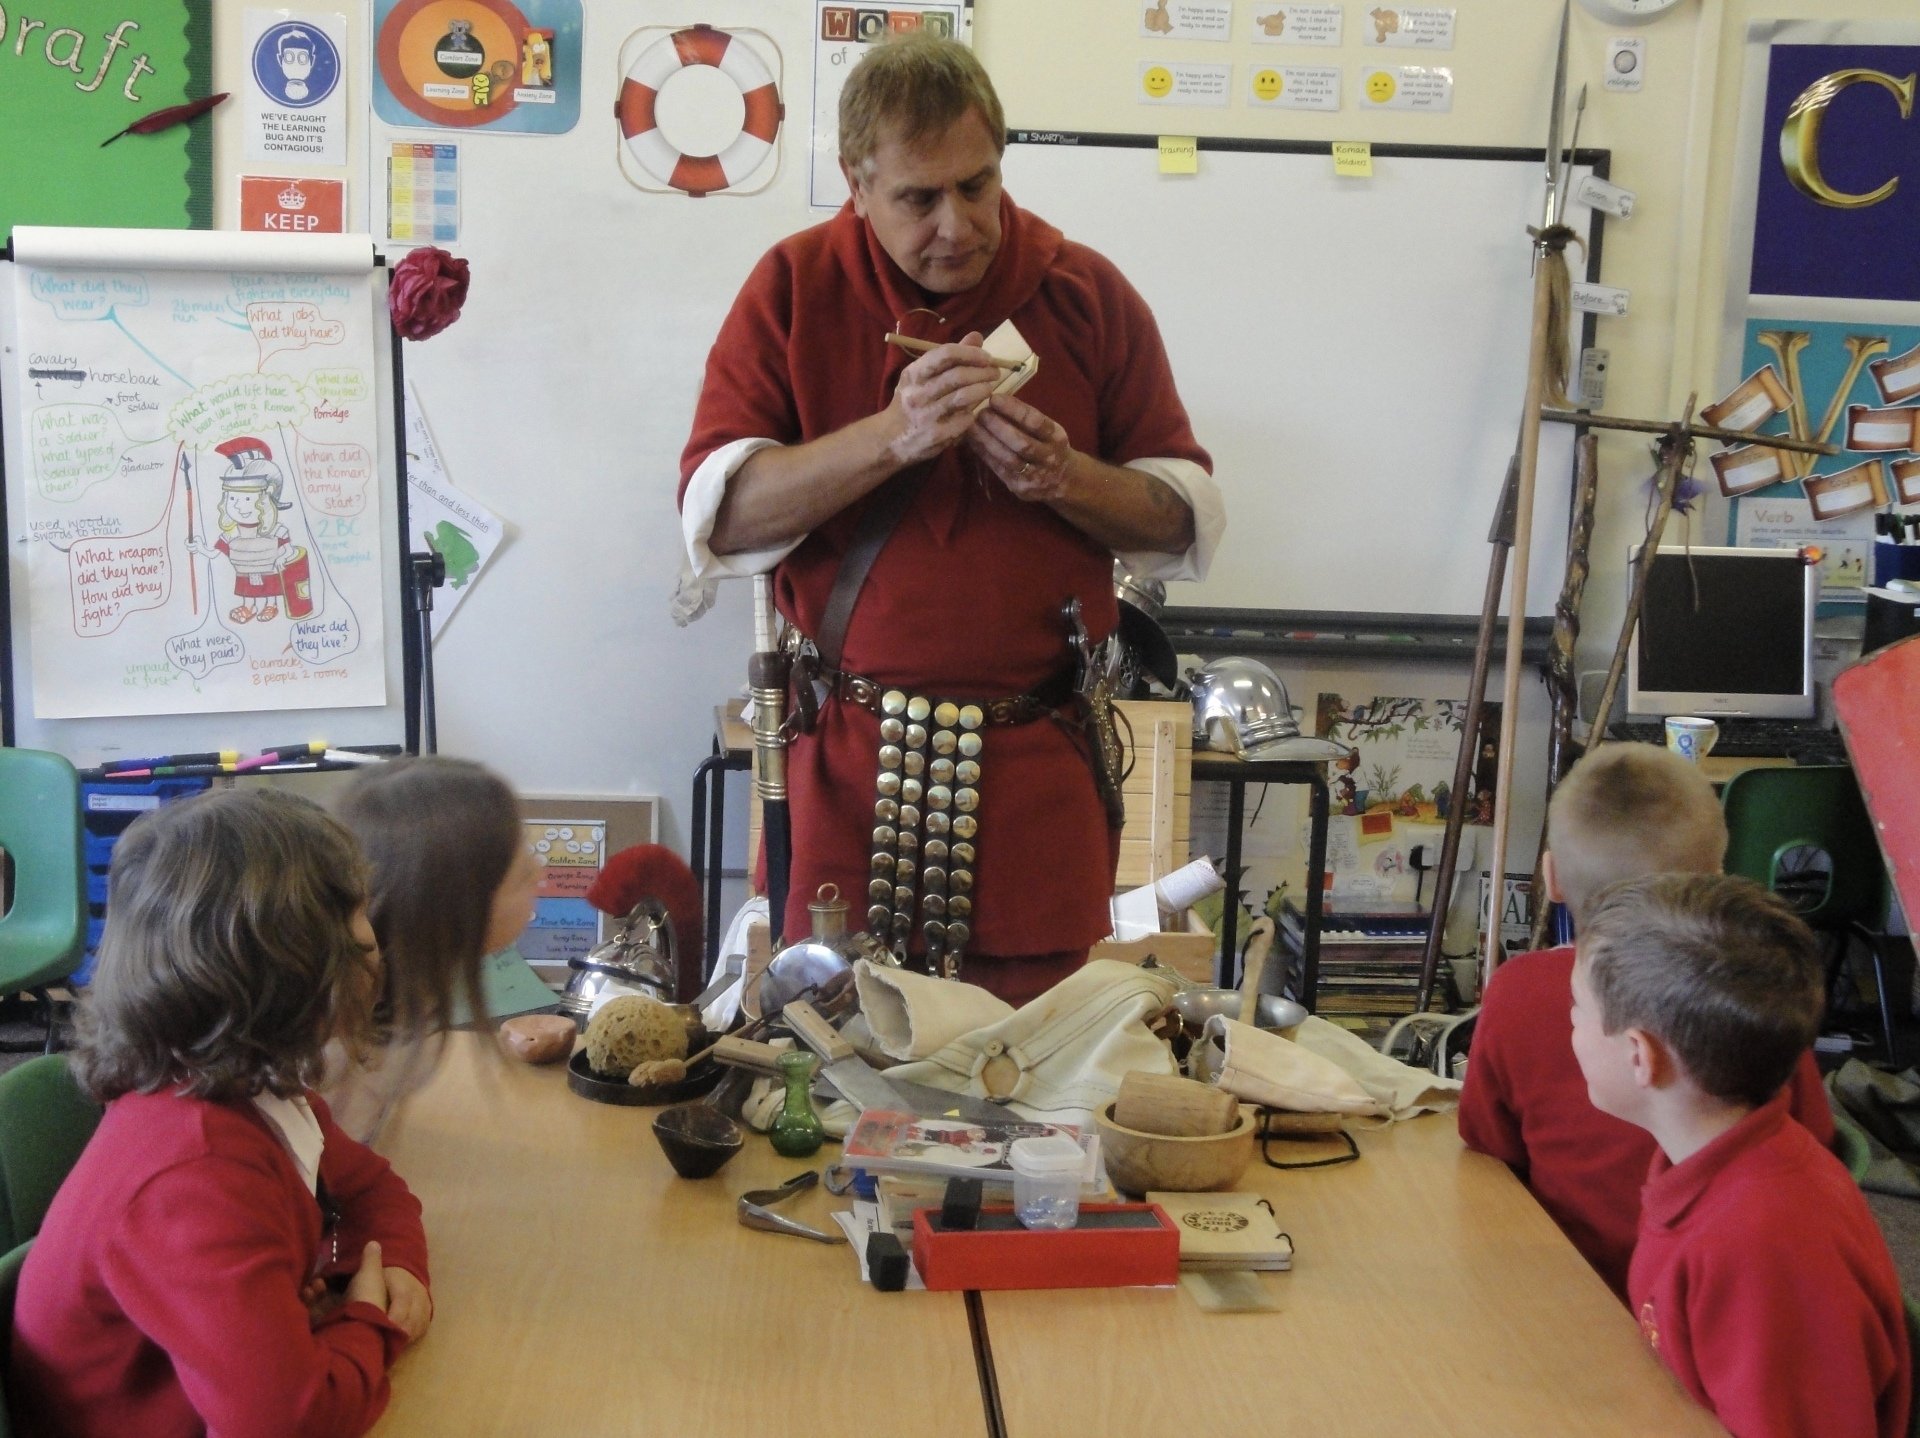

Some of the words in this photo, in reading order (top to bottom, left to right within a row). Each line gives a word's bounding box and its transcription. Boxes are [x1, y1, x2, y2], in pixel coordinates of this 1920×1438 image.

[830, 47, 847, 65] of
[261, 113, 288, 122] WE'VE
[290, 114, 327, 123] CAUGHT
[262, 123, 280, 131] THE
[281, 124, 326, 133] LEARNING
[1030, 132, 1058, 142] SMART
[266, 133, 284, 142] BUG
[286, 134, 305, 142] AND
[306, 135, 323, 143] IT'S
[1780, 69, 1917, 209] C
[264, 143, 324, 153] CONTAGIOUS!
[1336, 146, 1367, 154] Roman
[264, 213, 319, 231] KEEP
[38, 278, 75, 294] What
[1574, 291, 1602, 304] Before
[250, 307, 282, 323] What
[291, 308, 315, 327] jobs
[259, 327, 280, 340] did
[282, 327, 308, 346] they
[176, 402, 208, 428] What
[210, 387, 240, 406] would
[244, 384, 262, 398] life
[266, 384, 288, 398] have
[419, 478, 437, 496] than
[439, 494, 454, 508] and
[456, 504, 470, 519] less
[471, 516, 489, 531] than
[30, 520, 62, 531] used
[1754, 510, 1794, 523] Verb
[76, 528, 89, 537] to
[93, 526, 122, 536] train
[76, 548, 114, 568] What
[119, 546, 164, 562] weapons
[78, 570, 100, 586] did
[101, 566, 128, 588] they
[131, 561, 165, 576] have?
[82, 589, 108, 606] How
[112, 586, 132, 599] did
[135, 582, 162, 600] they
[82, 602, 120, 628] fight?
[297, 622, 328, 636] Where
[330, 620, 350, 632] did
[172, 638, 200, 654] What
[206, 634, 234, 648] were
[295, 638, 320, 658] they
[180, 650, 206, 673] they
[210, 644, 240, 664] paid?
[252, 673, 262, 685] 8
[263, 672, 298, 686] people
[302, 670, 310, 678] 2
